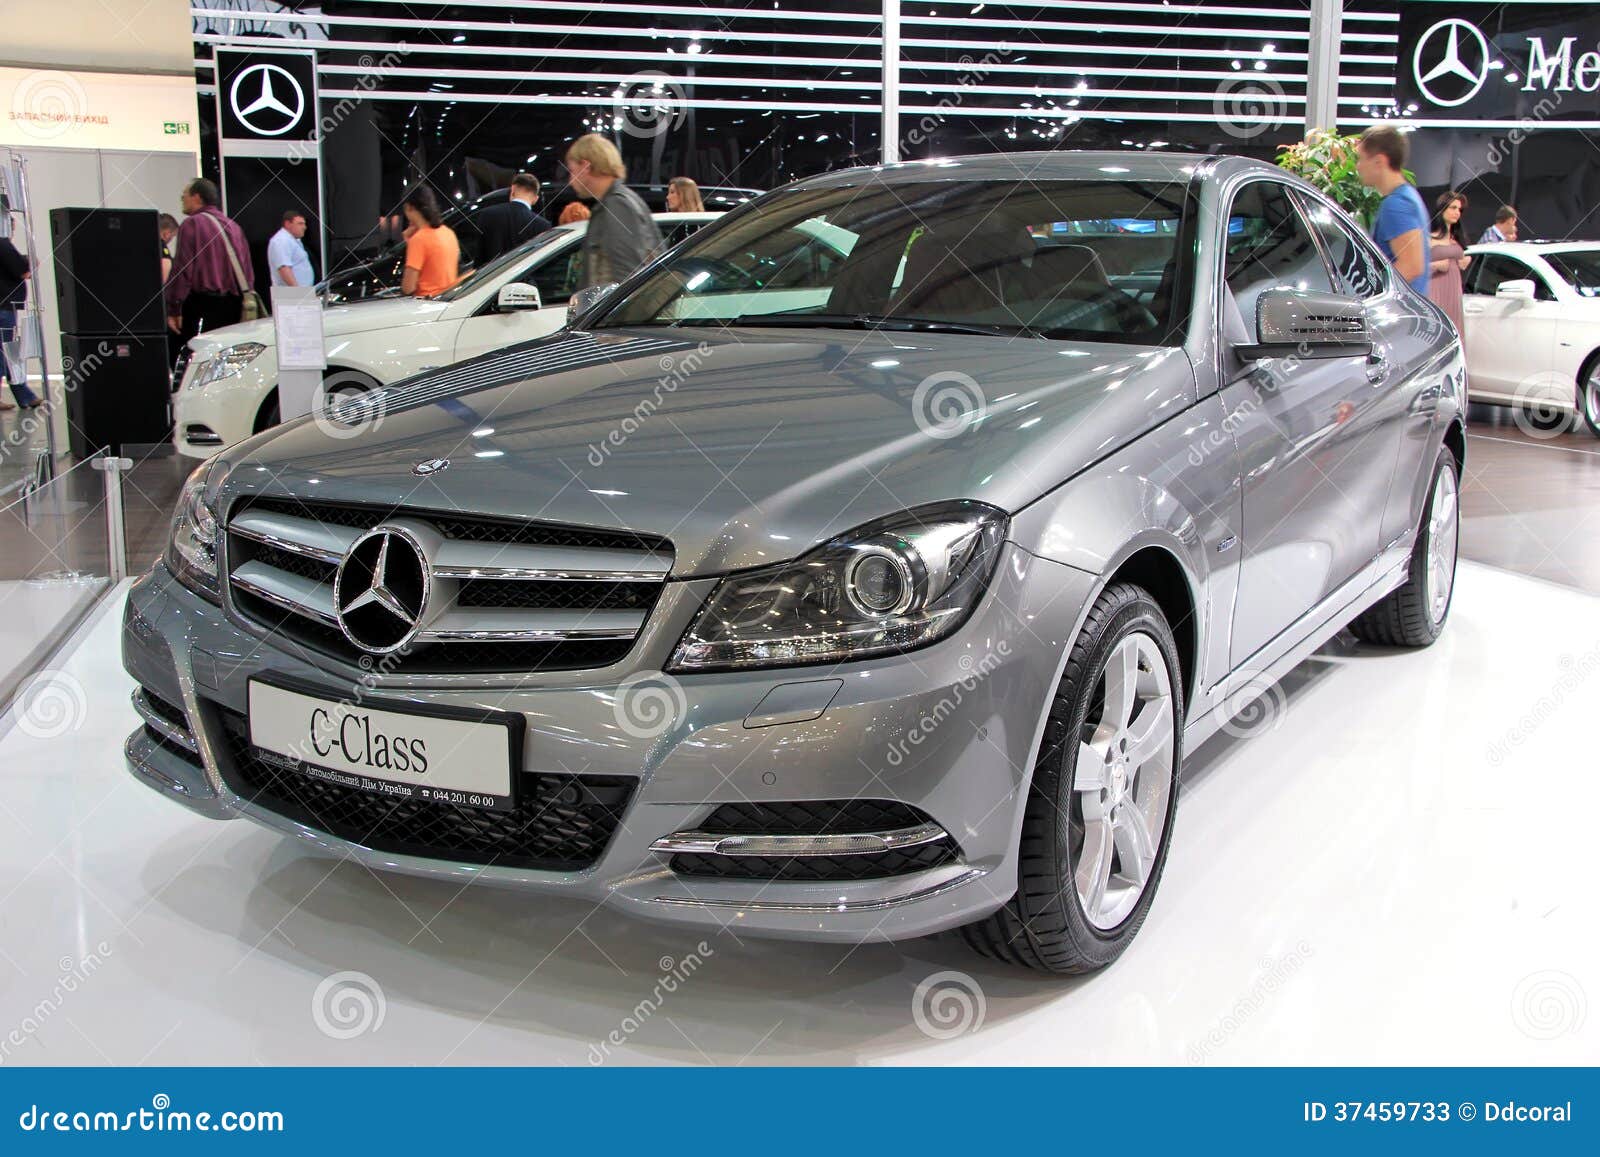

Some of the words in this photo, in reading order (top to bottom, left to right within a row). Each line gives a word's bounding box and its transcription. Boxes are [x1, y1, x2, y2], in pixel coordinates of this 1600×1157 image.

[1520, 36, 1600, 93] Me
[310, 708, 428, 773] C-Class
[361, 778, 377, 791] Дім
[378, 781, 412, 796] Україна
[433, 790, 449, 801] 044
[451, 792, 467, 804] 201
[469, 795, 481, 805] 60
[482, 796, 494, 807] 00
